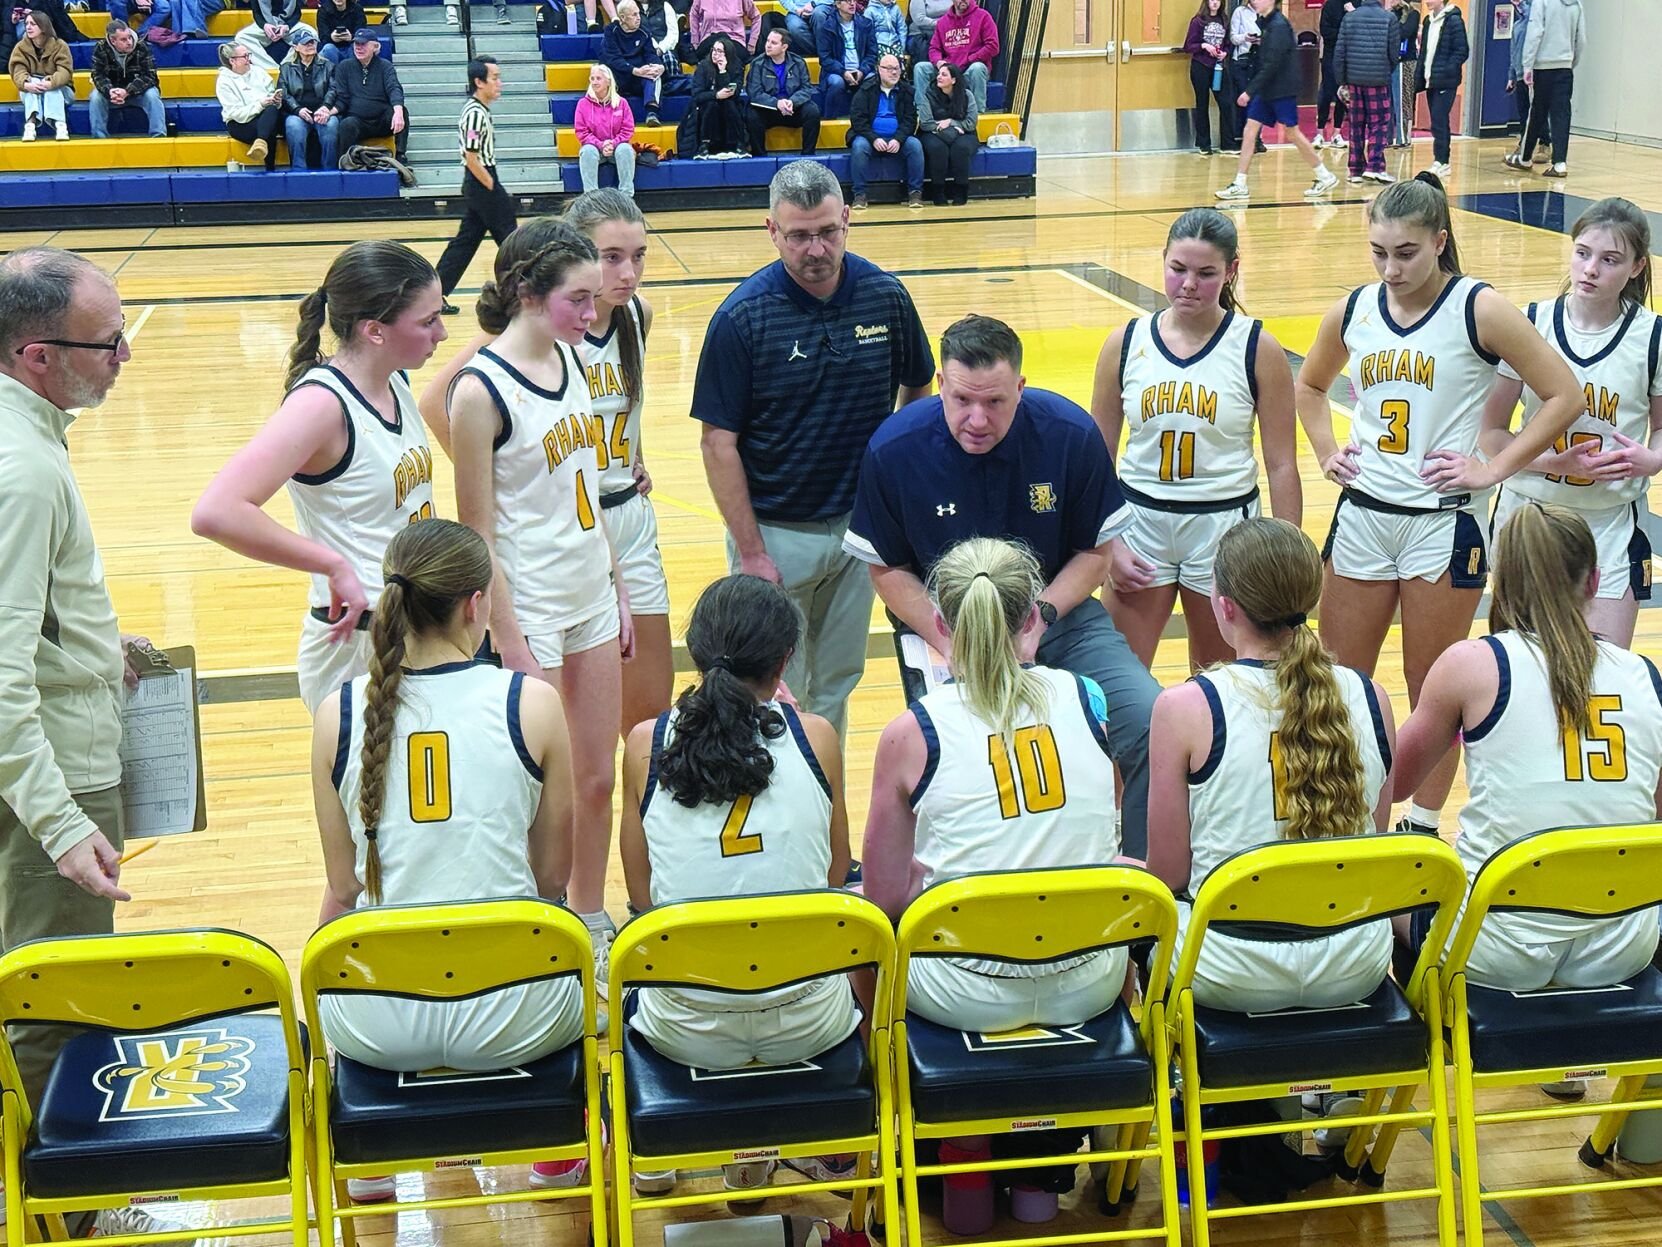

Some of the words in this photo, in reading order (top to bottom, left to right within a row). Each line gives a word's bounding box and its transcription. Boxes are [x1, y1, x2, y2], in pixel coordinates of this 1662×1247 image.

[1361, 348, 1435, 392] RHAM
[1141, 380, 1218, 426] RHAM
[1377, 398, 1411, 455] 3
[1158, 430, 1196, 482] 11
[575, 468, 596, 531] 1
[1467, 547, 1481, 575] R
[1558, 693, 1629, 782] 15
[407, 730, 453, 824] 0
[987, 723, 1067, 821] 10
